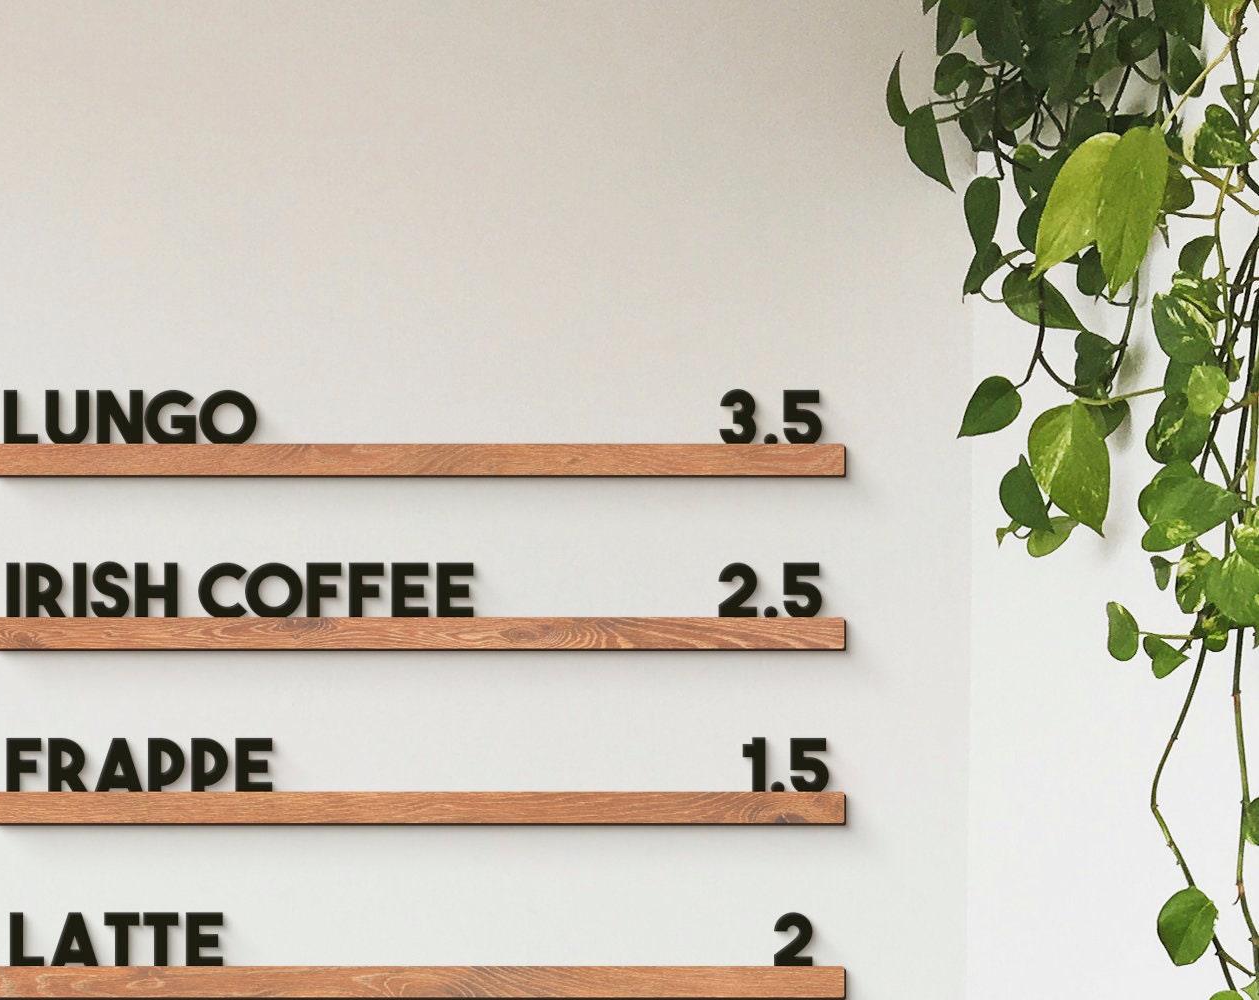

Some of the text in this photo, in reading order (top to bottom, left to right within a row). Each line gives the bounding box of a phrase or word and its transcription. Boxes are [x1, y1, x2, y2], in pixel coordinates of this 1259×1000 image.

[3, 389, 823, 444] LUNGO 3.5
[6, 561, 823, 617] IRISH COFFEE 2.5
[6, 737, 830, 792] FRAPPE 1.5
[9, 912, 814, 966] LATTE 2
